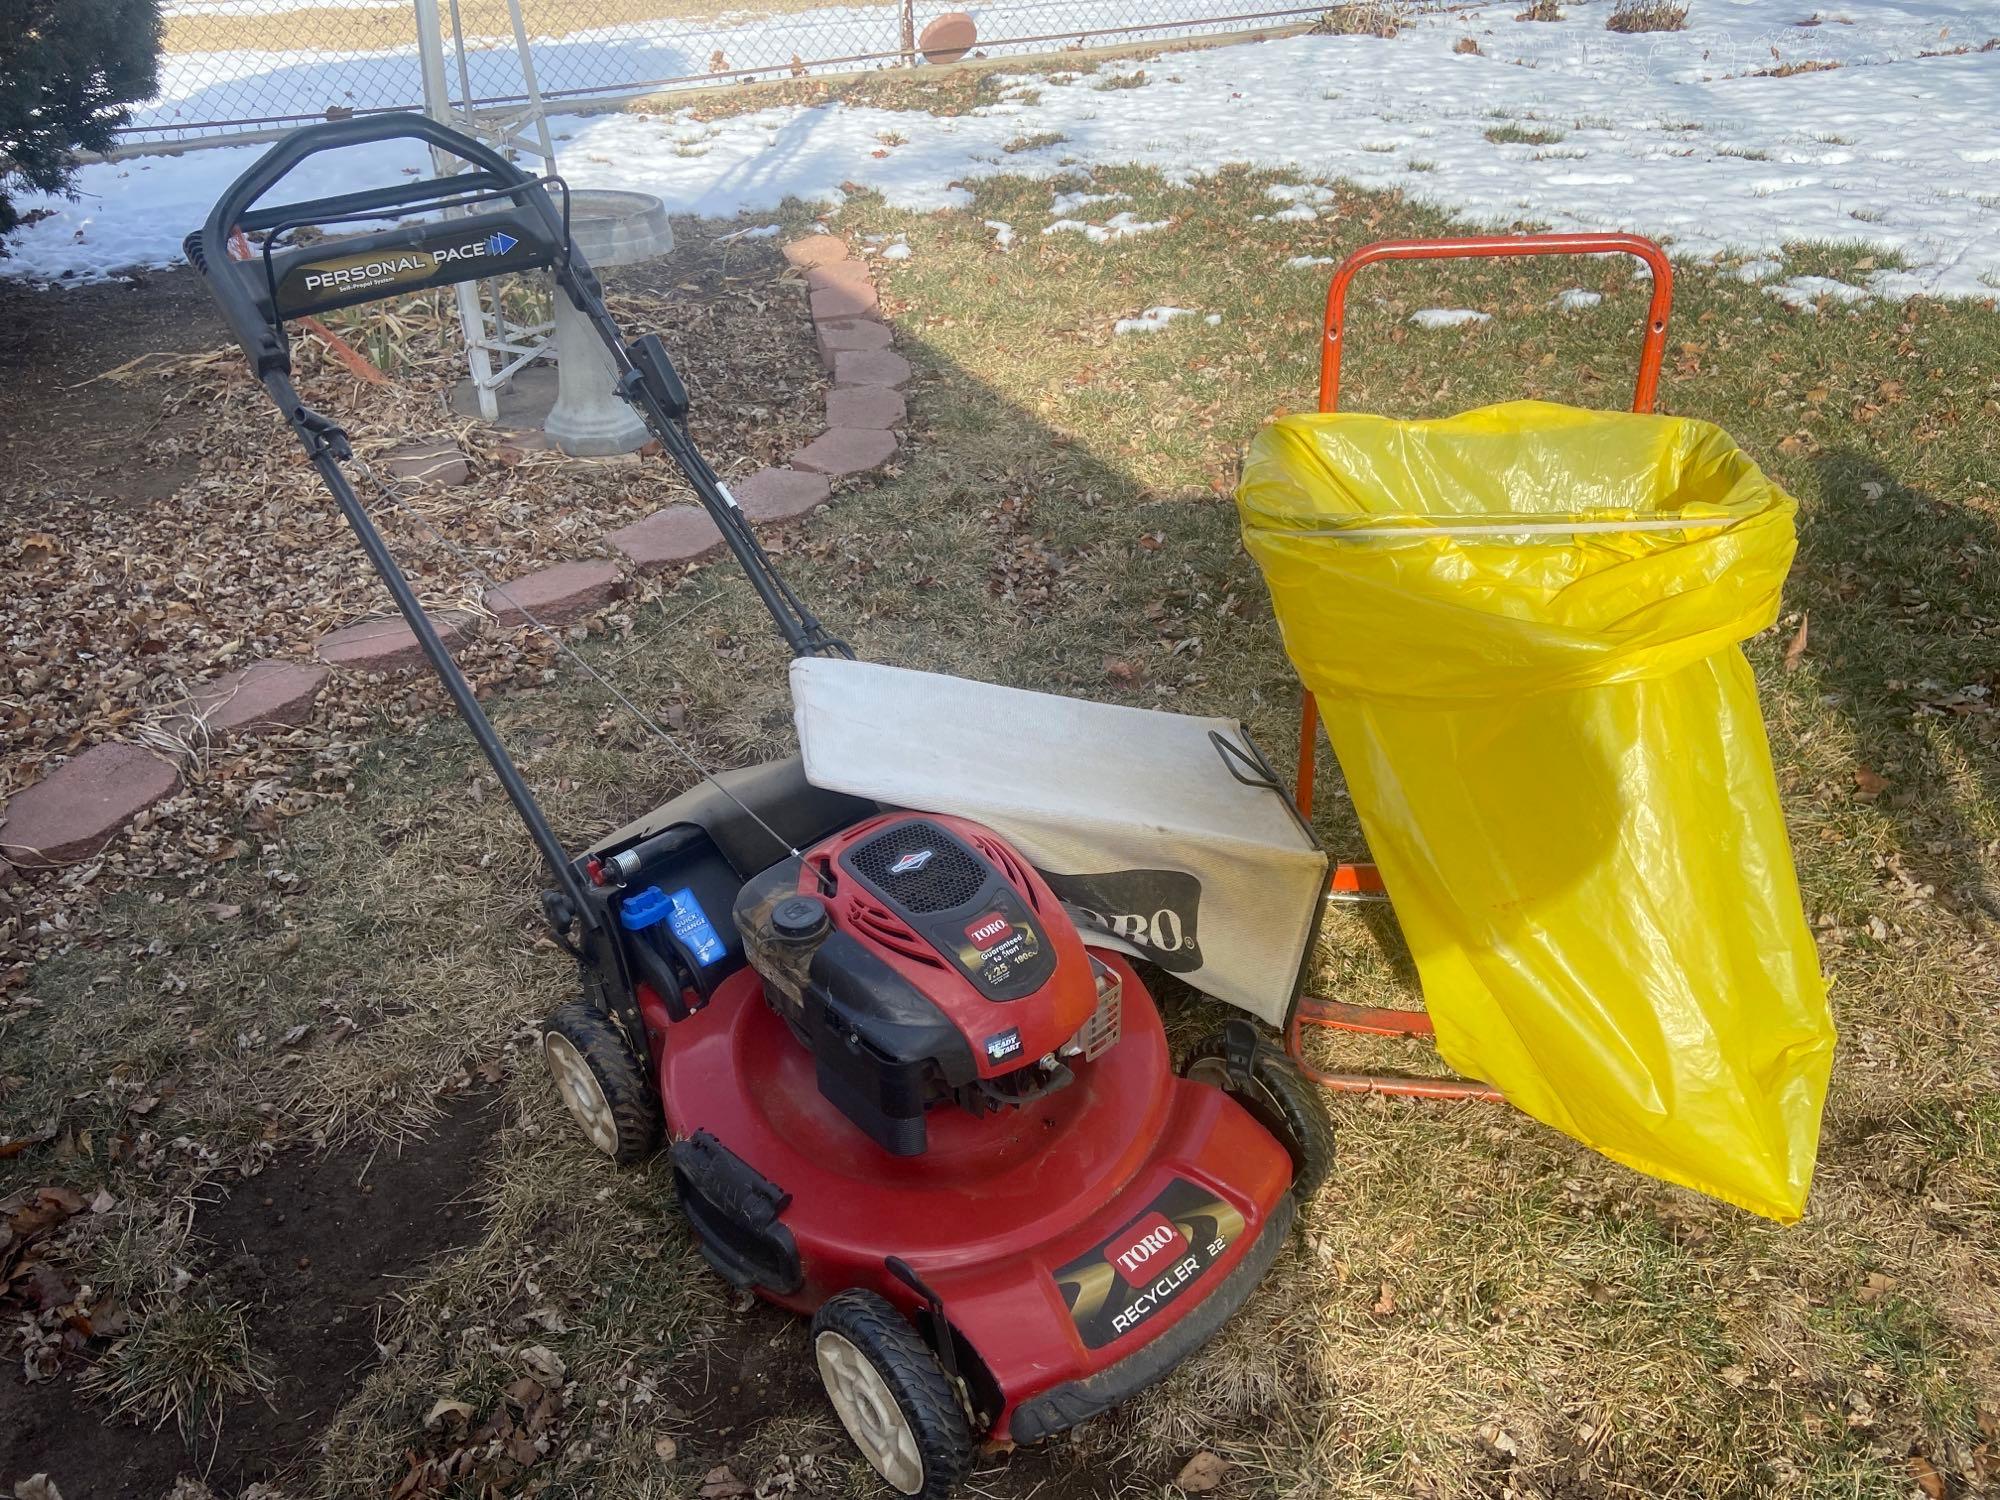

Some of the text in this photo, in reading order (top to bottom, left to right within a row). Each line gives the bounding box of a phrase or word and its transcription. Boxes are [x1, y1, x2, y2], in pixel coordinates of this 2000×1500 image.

[305, 242, 485, 291] PERSONAL PACE
[374, 277, 395, 286] System
[677, 918, 706, 936] CHANGE
[971, 919, 1006, 942] TORO
[1079, 906, 1183, 951] RO
[981, 933, 1023, 960] Guaranteed
[1117, 1225, 1174, 1273] TORO
[1111, 1256, 1201, 1334] RECYCLER
